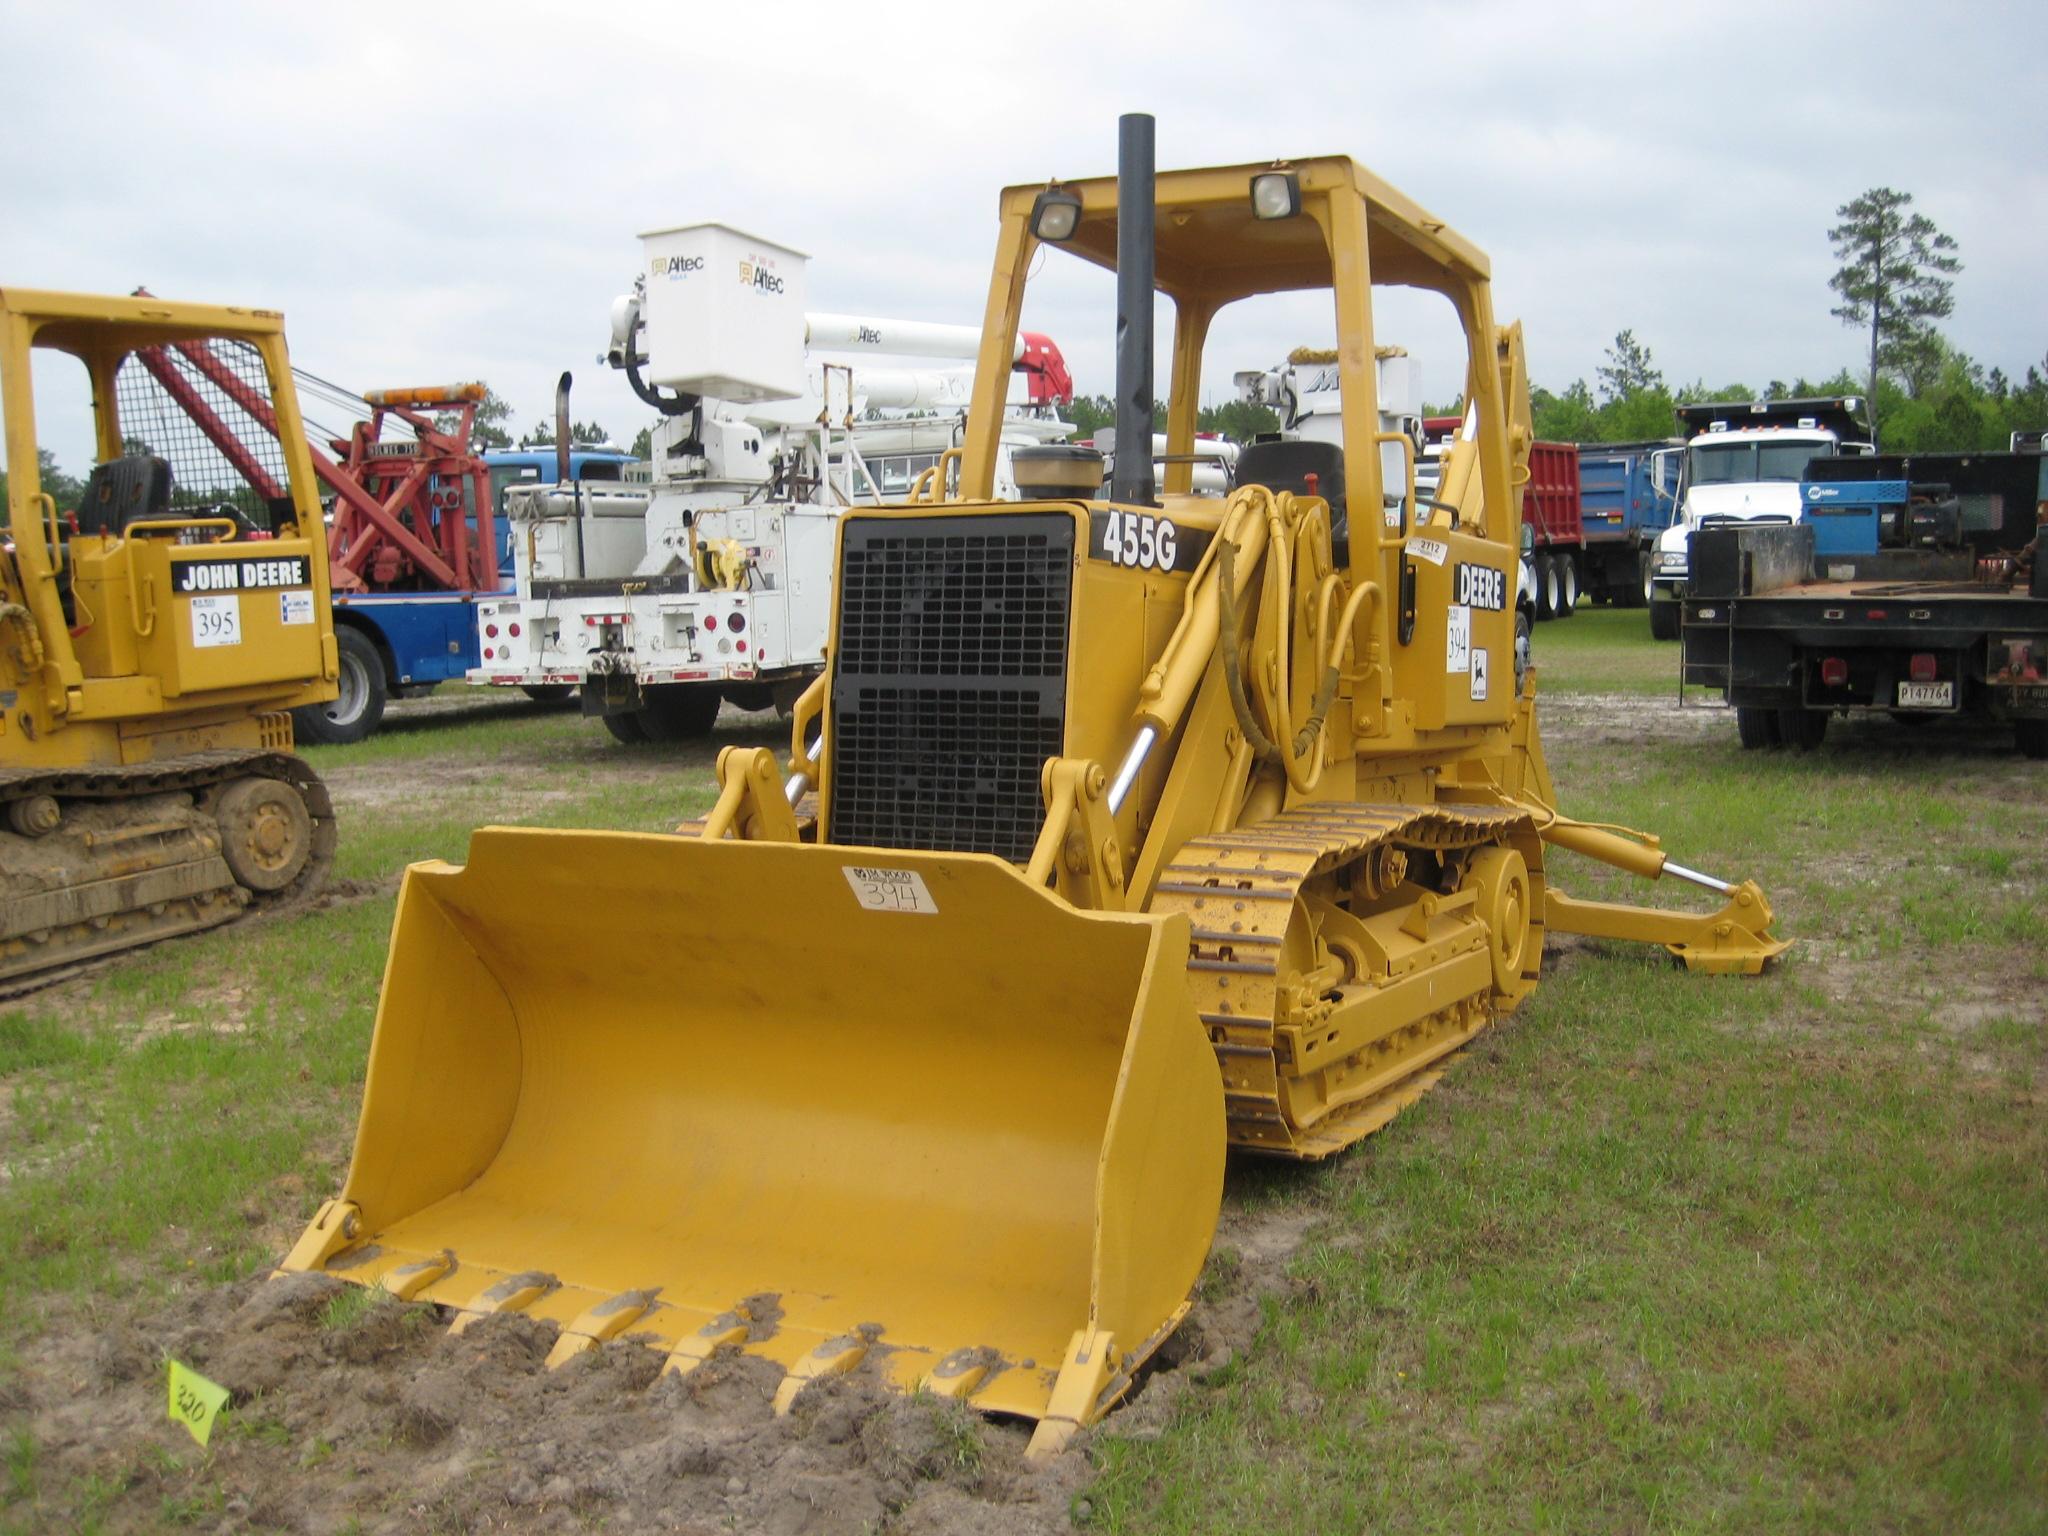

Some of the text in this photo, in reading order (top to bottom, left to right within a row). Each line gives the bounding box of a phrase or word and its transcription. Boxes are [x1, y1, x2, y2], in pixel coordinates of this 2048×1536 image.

[668, 256, 704, 274] Altec
[753, 266, 784, 294] Altec
[1103, 510, 1177, 571] 455G
[1420, 540, 1441, 554] 2712
[182, 561, 303, 591] JOHN DEERE
[1460, 563, 1501, 610] DEERE
[199, 611, 235, 637] 395
[1448, 627, 1467, 659] 394
[863, 881, 918, 910] 394
